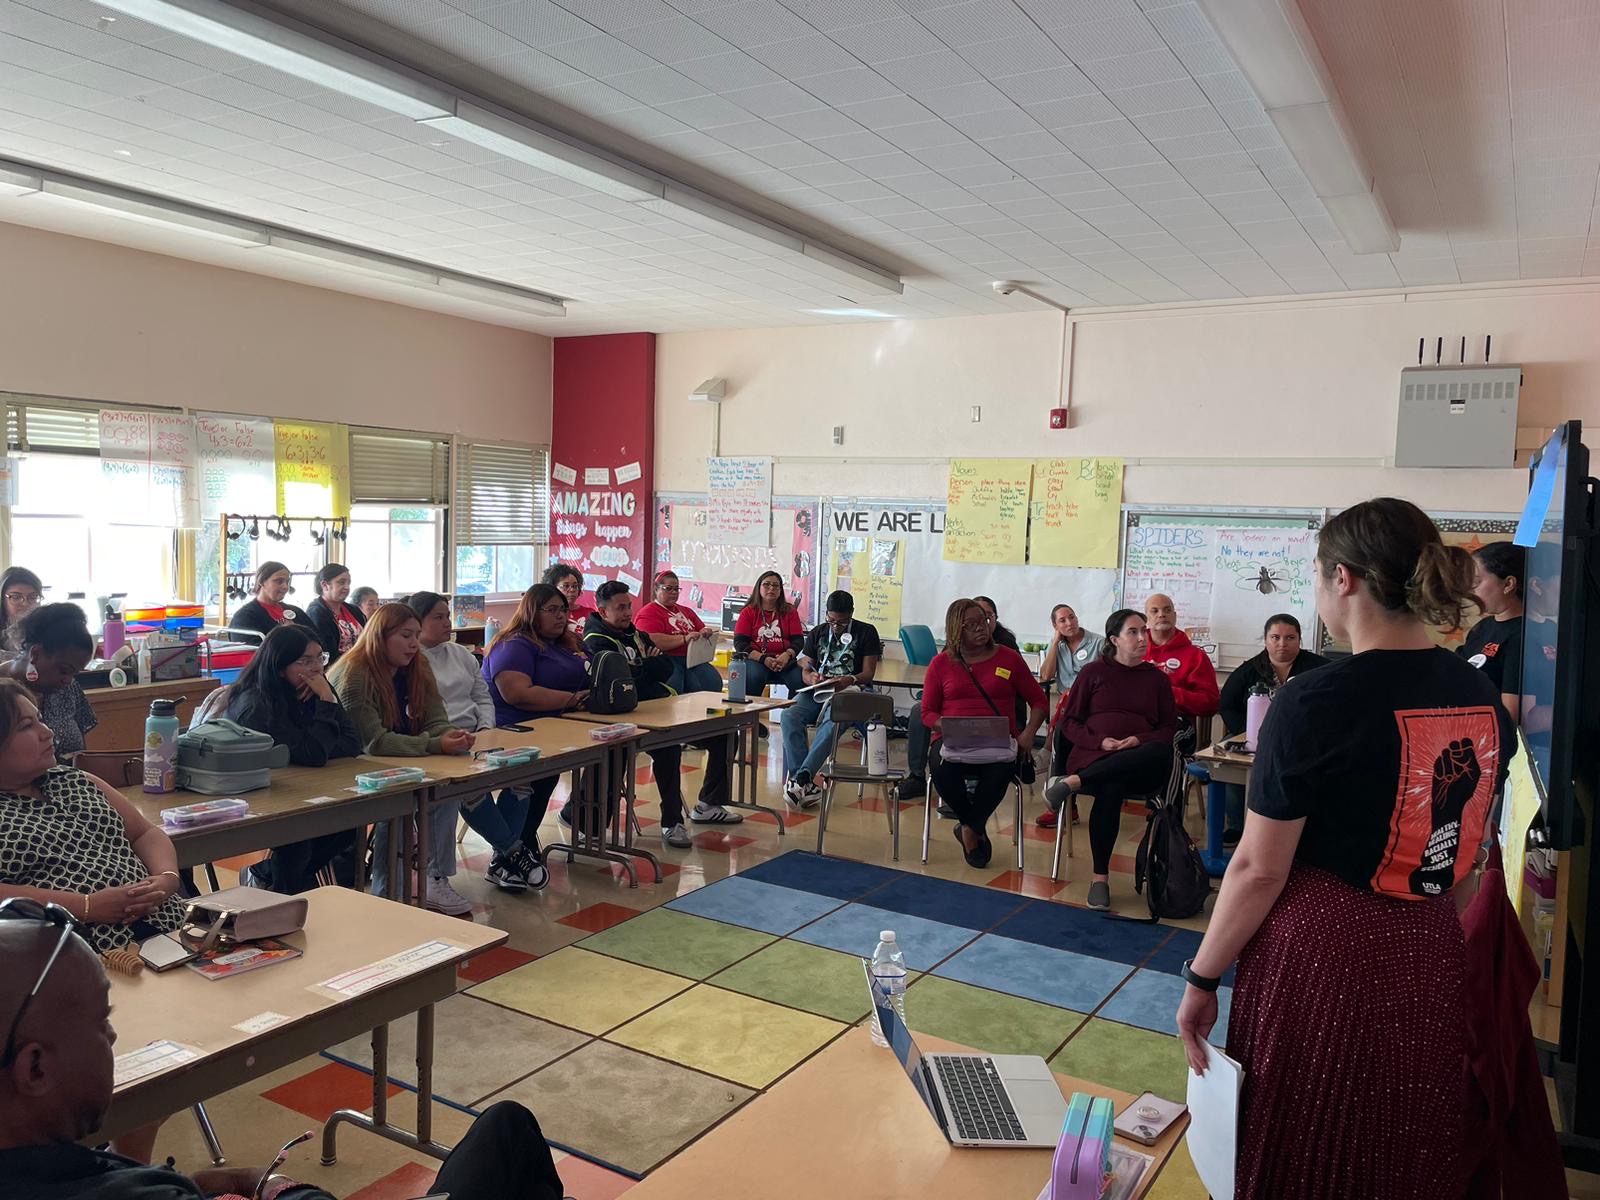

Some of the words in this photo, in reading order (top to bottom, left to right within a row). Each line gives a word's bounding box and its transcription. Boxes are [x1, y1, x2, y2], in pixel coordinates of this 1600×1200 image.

[552, 491, 636, 517] AMAZING
[834, 511, 869, 532] WE
[877, 511, 922, 532] ARE
[594, 521, 632, 542] happen
[1135, 527, 1204, 546] SPIDERS
[1221, 545, 1232, 556] No
[1236, 545, 1253, 559] they
[1424, 837, 1457, 857] RACIALLY
[1420, 857, 1454, 871] SCHOOLS
[1430, 850, 1449, 864] JUST
